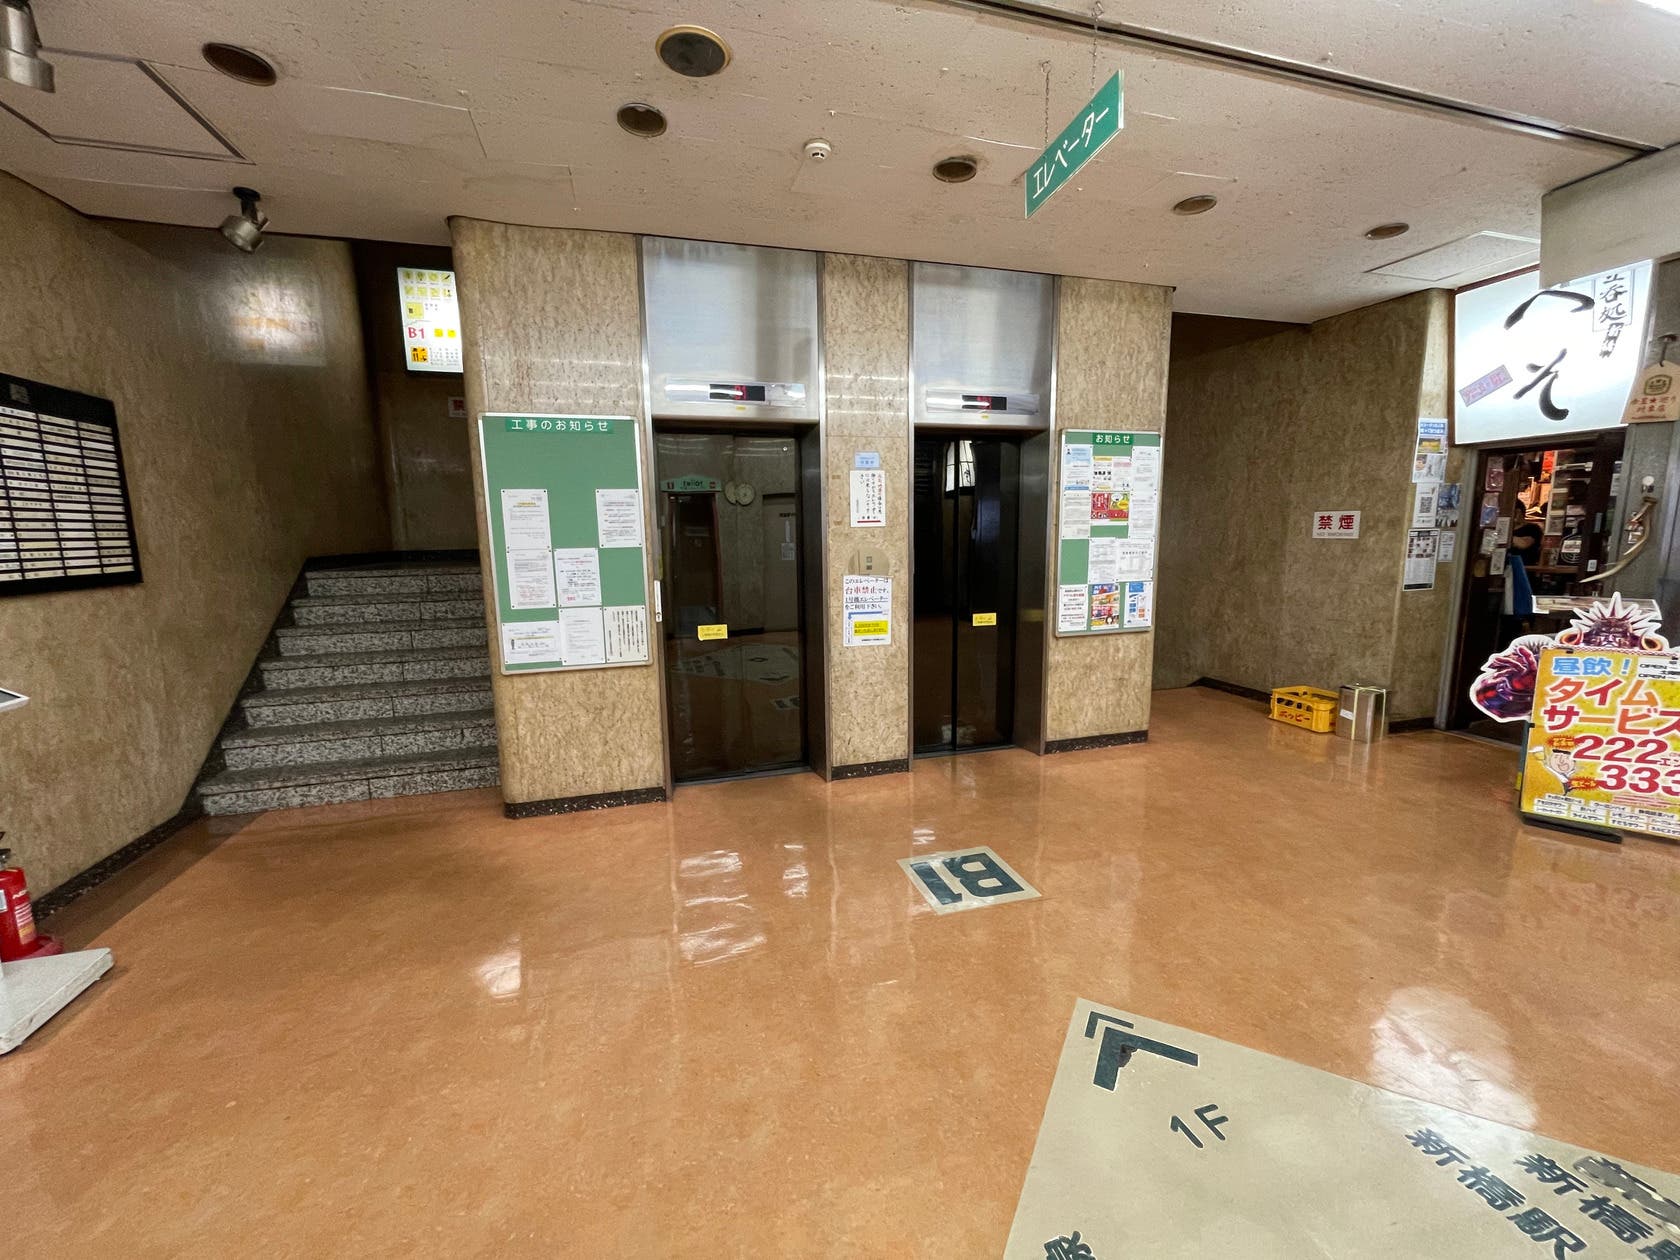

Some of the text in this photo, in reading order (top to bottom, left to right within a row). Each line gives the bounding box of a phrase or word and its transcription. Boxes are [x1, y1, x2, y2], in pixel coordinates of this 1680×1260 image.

[1033, 108, 1110, 199] エレベーター
[408, 327, 425, 339] B1
[511, 419, 609, 432] 工事のお知らせ
[1095, 434, 1130, 444] お知らせ
[1317, 514, 1355, 530] 禁煙
[1549, 677, 1658, 707] タイム
[1573, 735, 1668, 765] 222
[910, 852, 1025, 906] B1
[1170, 1103, 1229, 1149] 1F
[1404, 1127, 1588, 1260] 新橋駅
